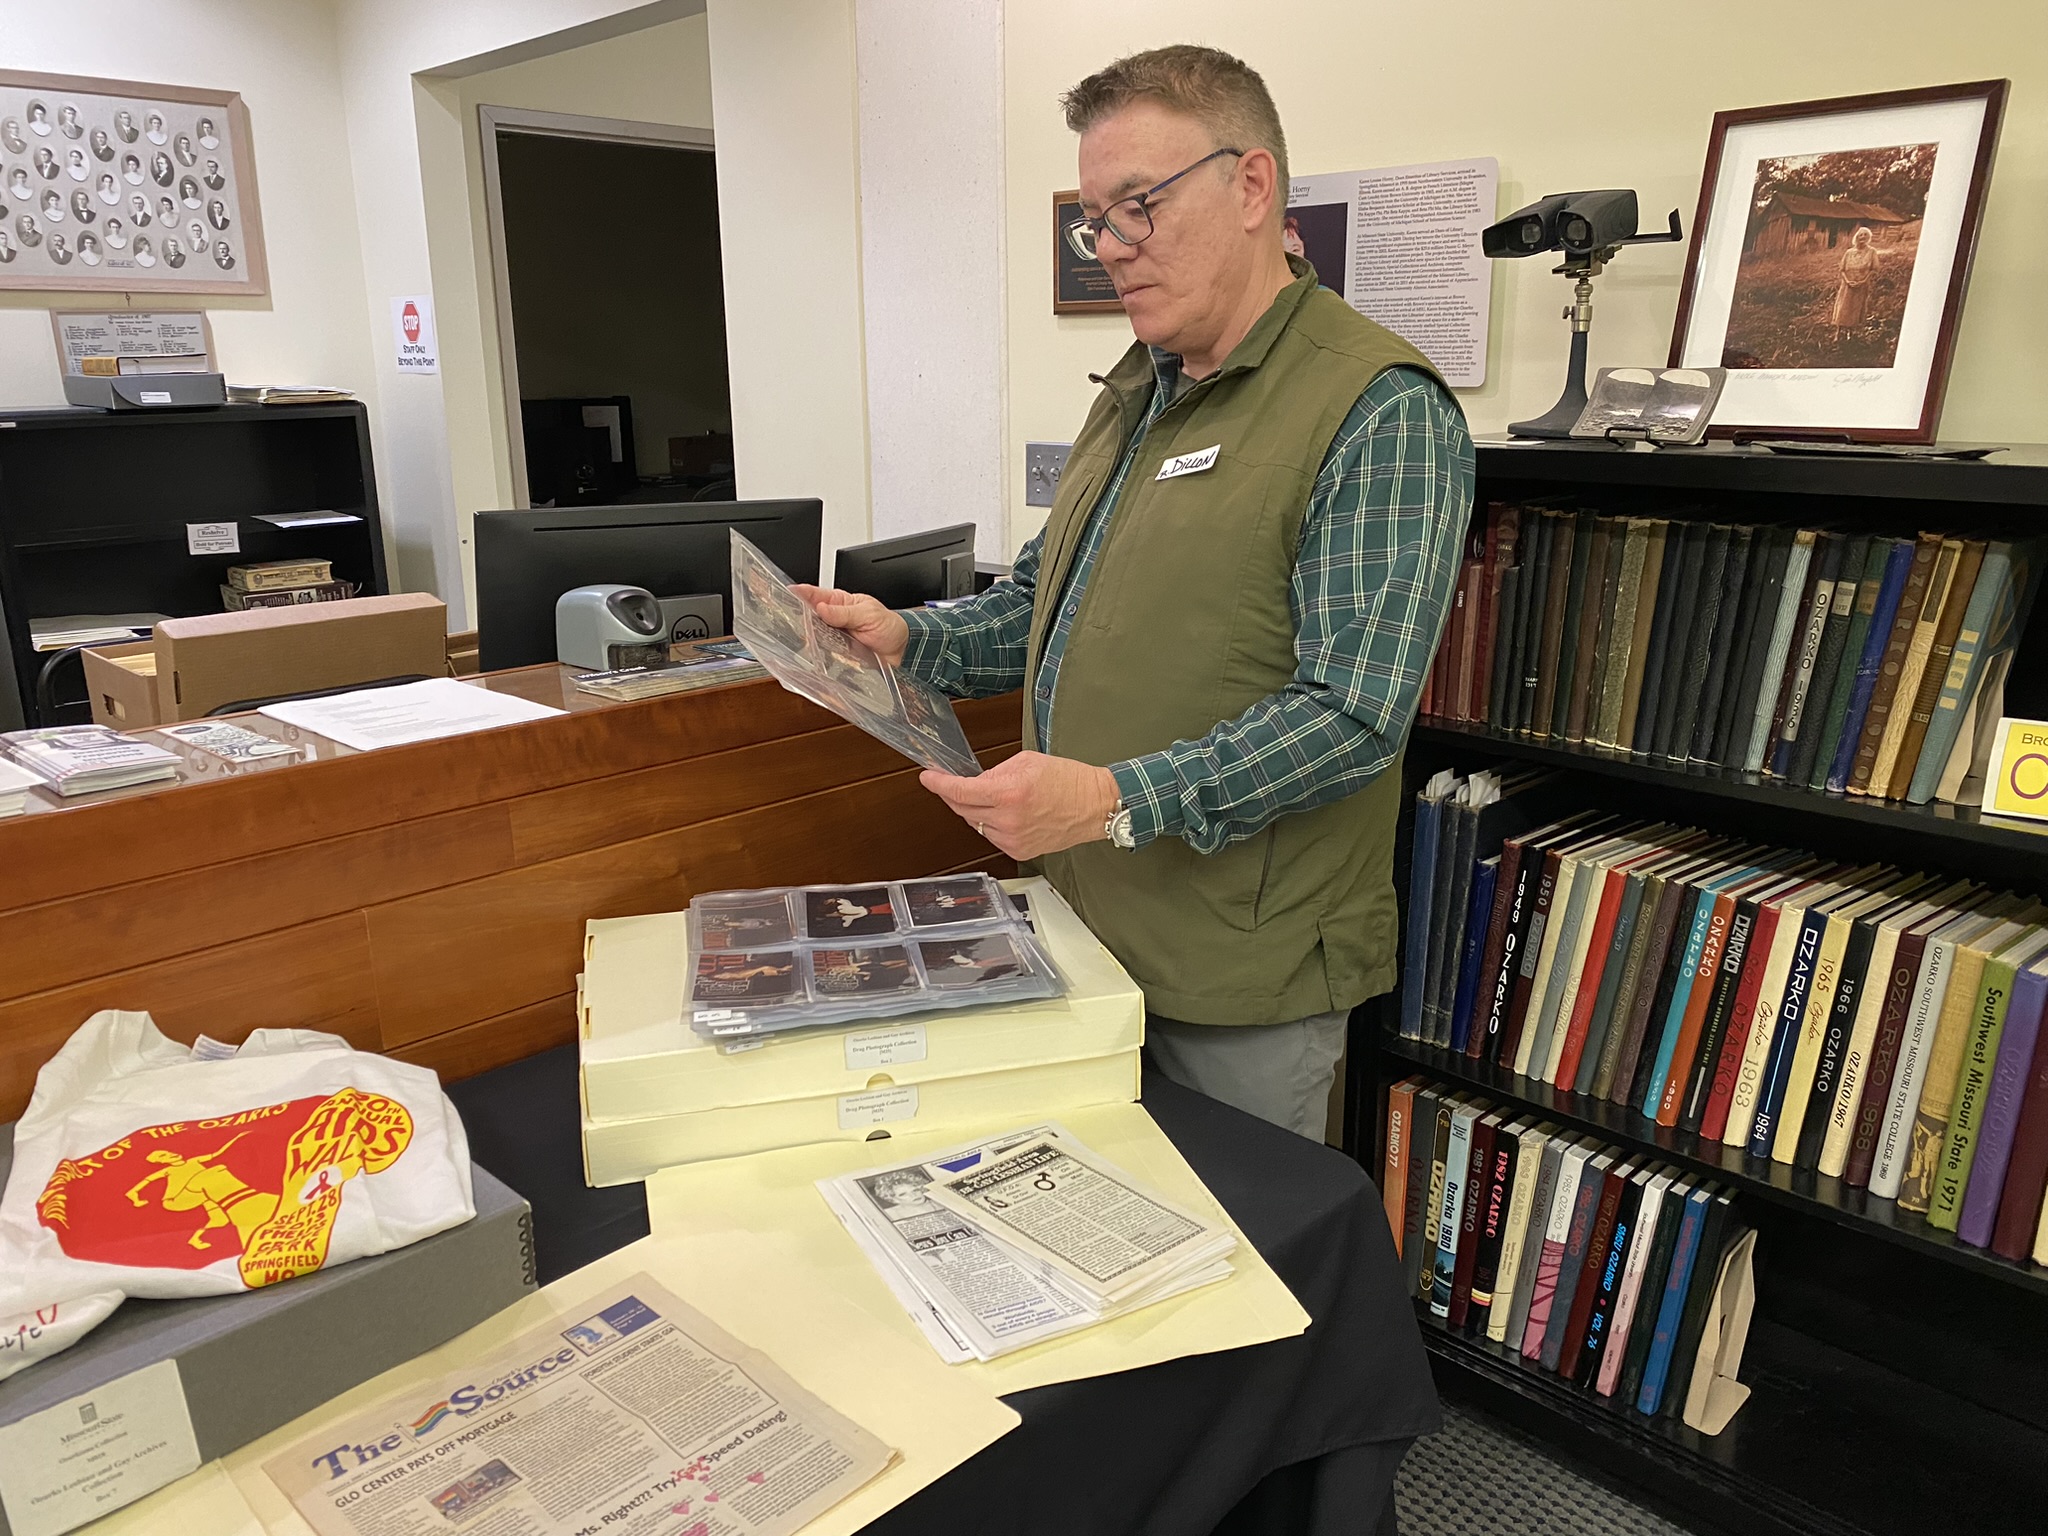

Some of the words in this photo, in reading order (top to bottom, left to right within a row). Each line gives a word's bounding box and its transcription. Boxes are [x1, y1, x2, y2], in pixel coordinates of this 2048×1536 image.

[404, 315, 418, 330] STOP
[676, 628, 706, 640] DELL
[1802, 593, 1828, 670] OZARKO
[1787, 680, 1804, 729] 1936
[1512, 870, 1527, 923] 1949
[1538, 874, 1552, 906] 1950
[1522, 917, 1542, 974] OZARKO
[1699, 916, 1725, 977] OZARKO
[1723, 914, 1751, 974] OZARKO
[1489, 934, 1516, 1034] OZARKO
[1784, 927, 1818, 1021] OZARKO
[1816, 958, 1835, 994] 1965
[1927, 946, 1943, 985] OZARKO
[1838, 978, 1855, 1014] 1966
[1912, 987, 1933, 1045] SOUTHWEST
[866, 1043, 893, 1051] Photograph
[894, 1039, 917, 1047] Collection
[1872, 968, 1910, 1086] OZARKO
[1976, 988, 2003, 1064] Southwest
[1713, 1002, 1748, 1096] OZARKO
[1817, 1028, 1842, 1092] OZARKO
[1900, 1046, 1919, 1090] MISSOURI
[886, 1098, 909, 1106] Collection
[1664, 1080, 1676, 1110] 1960
[1735, 1057, 1759, 1108] 1963
[1836, 1050, 1862, 1129] OZARKO/1967
[1960, 1069, 1984, 1130] Missouri
[1856, 1099, 1880, 1150] 1968
[1893, 1091, 1907, 1120] STATE
[102, 1138, 132, 1160] OF
[142, 1123, 188, 1140] THE
[197, 1102, 290, 1130] OZARKS
[292, 1107, 406, 1156] AIDS
[1390, 1110, 1401, 1154] OZARKO
[1753, 1112, 1770, 1142] 1964
[1884, 1122, 1899, 1161] COLLEGE
[1034, 1150, 1060, 1166] LIFE
[1389, 1154, 1398, 1168] 77
[1472, 1148, 1483, 1174] 1981
[1494, 1150, 1508, 1182] 1982
[1879, 1162, 1889, 1180] 1969
[1949, 1133, 1968, 1170] State
[1424, 1160, 1445, 1242] OZARKO
[1442, 1181, 1459, 1220] Ozarko
[1510, 1181, 1527, 1226] OZARKO
[1564, 1174, 1573, 1194] 1985
[1938, 1177, 1957, 1212] 1971
[274, 1201, 316, 1226] SEPT.
[318, 1188, 338, 1212] 28
[1464, 1179, 1480, 1233] OZARKO
[1485, 1184, 1503, 1238] OZARKO
[1532, 1187, 1548, 1228] OZARKO
[1554, 1195, 1569, 1230] OZARKO
[1440, 1222, 1454, 1249] 1980
[1568, 1212, 1587, 1257] OZARKO
[1588, 1218, 1610, 1270] OZARKO
[1614, 1222, 1626, 1251] SMSU
[244, 1254, 320, 1274] SPRINGFIELD
[264, 1269, 296, 1284] MO
[1603, 1250, 1620, 1292] OZARKO
[1588, 1336, 1598, 1350] 76
[1590, 1312, 1604, 1336] VOL.
[612, 1344, 641, 1364] STUDENT
[312, 1433, 402, 1480] The
[450, 1347, 576, 1418] Source
[114, 1456, 132, 1470] Gay
[133, 1440, 168, 1460] Archives
[335, 1490, 360, 1509] GLO
[361, 1467, 407, 1494] CENTER
[407, 1453, 436, 1472] PAYS
[435, 1440, 458, 1457] OFF
[458, 1411, 518, 1446] MORTGAGE
[601, 1490, 654, 1526] Right???
[652, 1477, 678, 1496] Try
[703, 1436, 744, 1464] Speed
[743, 1410, 788, 1440] Dating!
